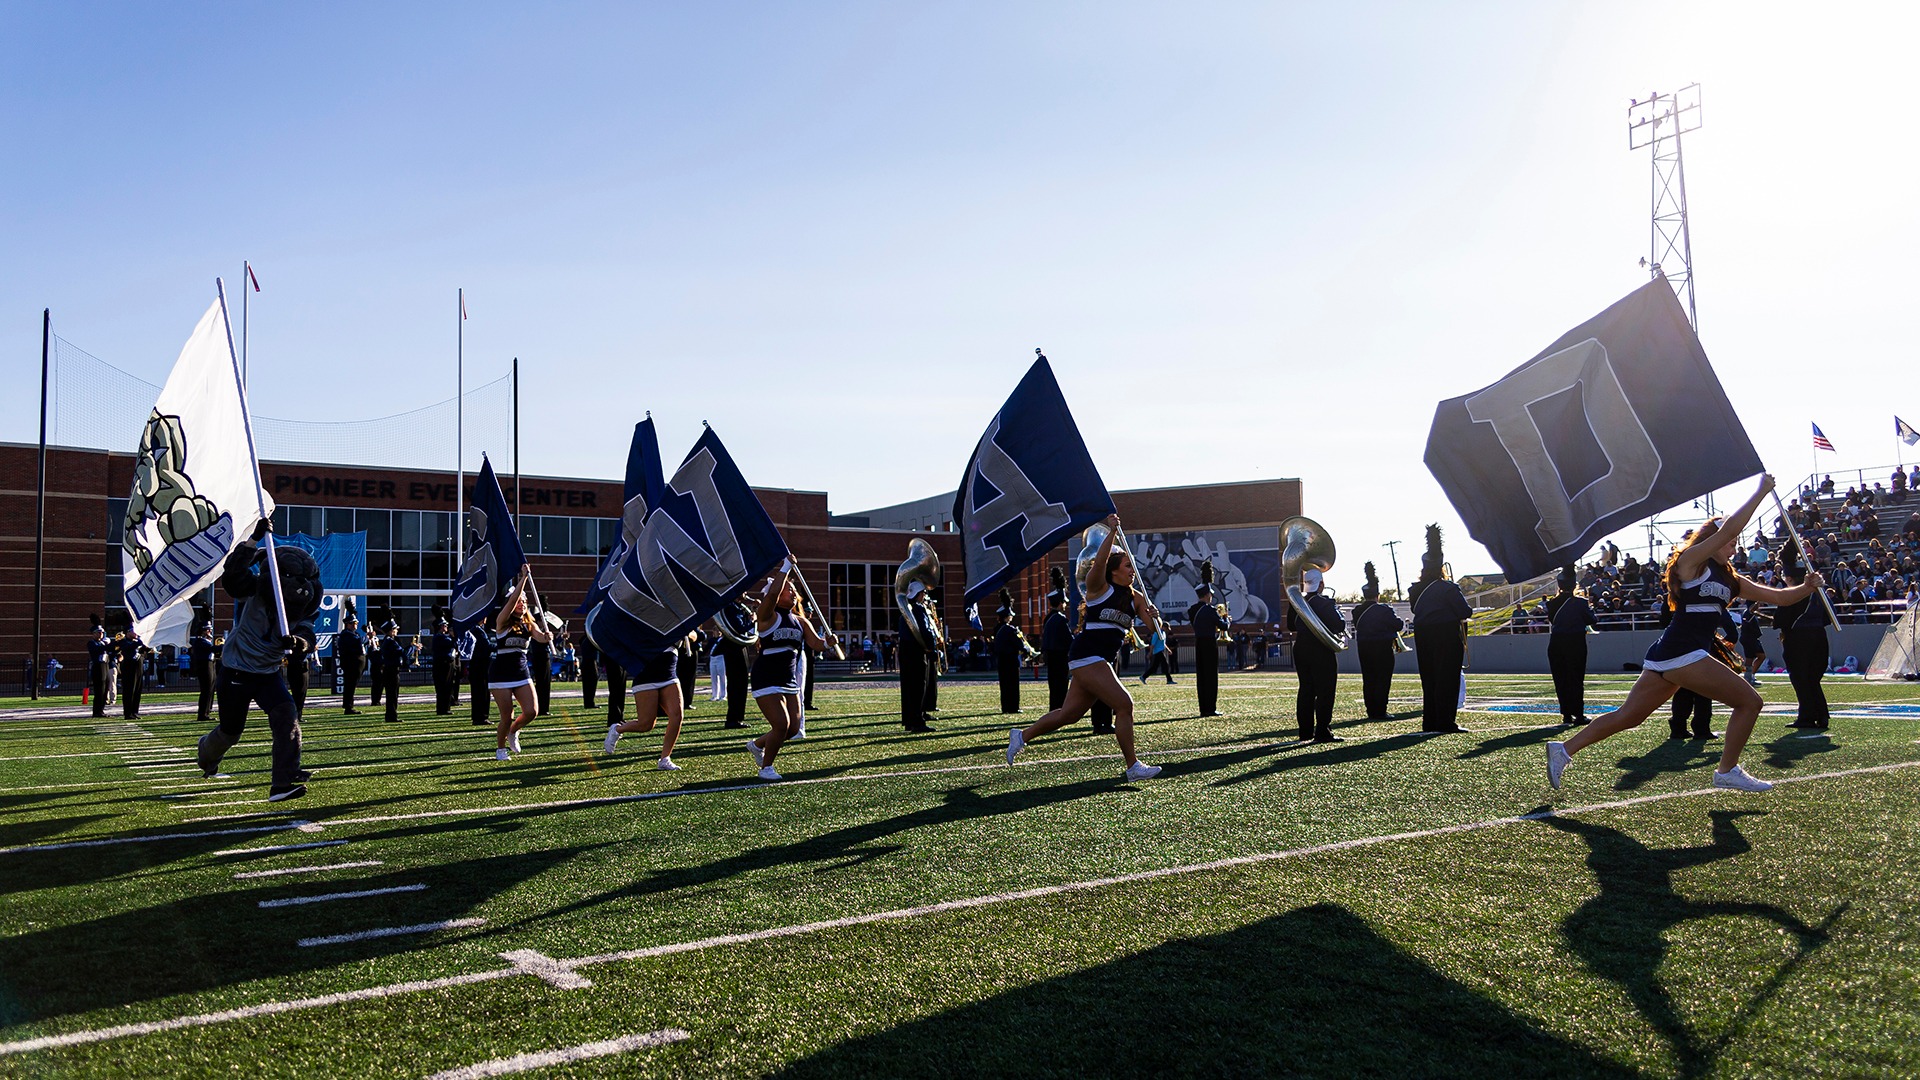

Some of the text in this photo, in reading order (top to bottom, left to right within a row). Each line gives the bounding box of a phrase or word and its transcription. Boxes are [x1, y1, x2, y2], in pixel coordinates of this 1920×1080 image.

[1465, 337, 1662, 553] D
[275, 475, 396, 499] PIONEER
[409, 481, 474, 504] EVEN
[961, 414, 1072, 597] A
[1698, 581, 1731, 604] SWOS
[1098, 608, 1132, 628] SWOS
[772, 627, 802, 642] SWOS
